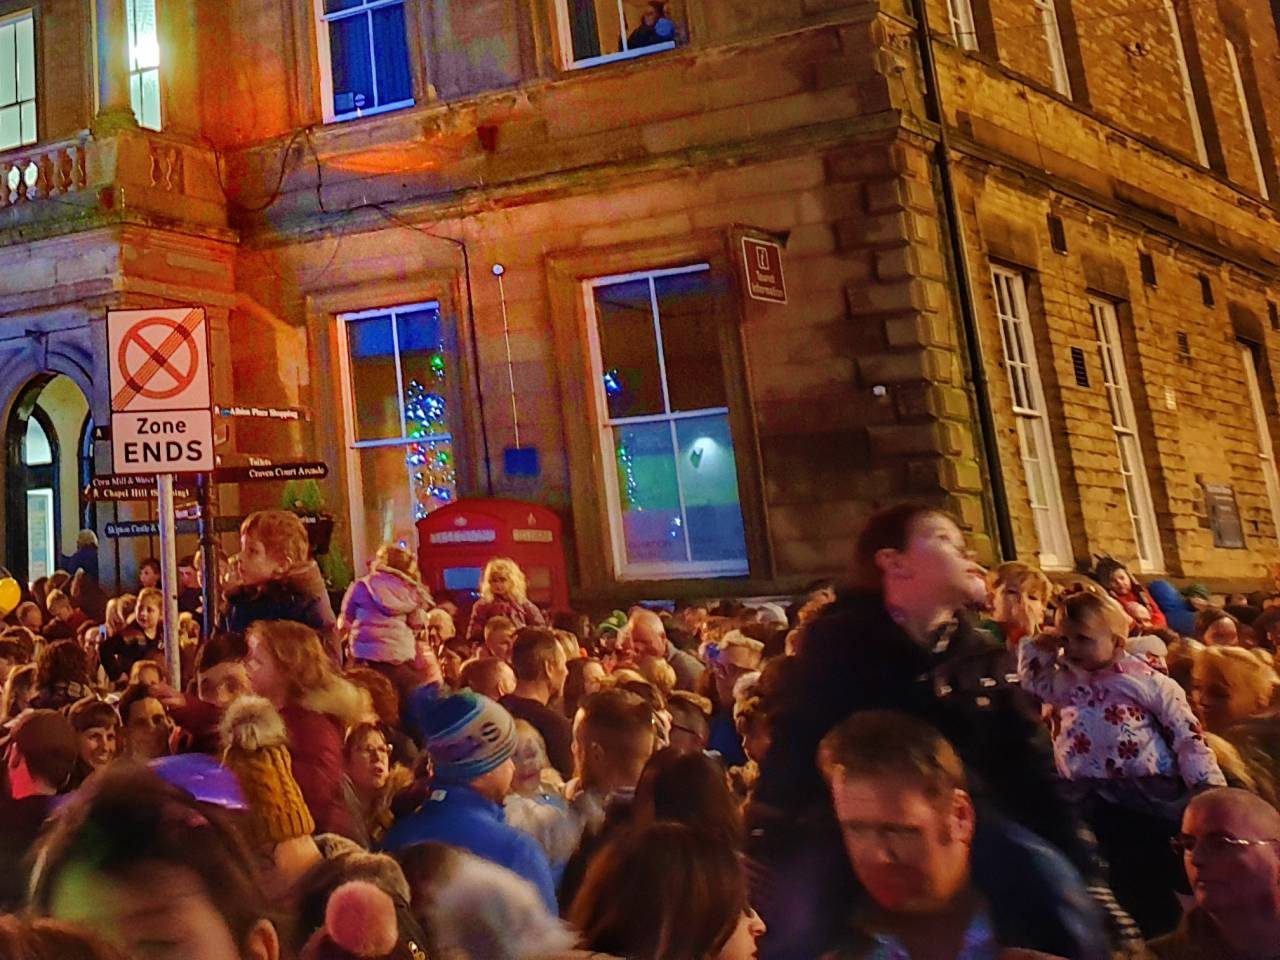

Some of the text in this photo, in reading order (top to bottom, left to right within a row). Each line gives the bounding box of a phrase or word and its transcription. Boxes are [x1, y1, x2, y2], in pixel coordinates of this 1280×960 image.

[136, 417, 187, 435] Zone
[124, 440, 203, 463] ENDS
[275, 467, 297, 477] Court
[111, 476, 127, 486] Mill
[103, 488, 129, 498] Chapel
[131, 488, 148, 497] Hill
